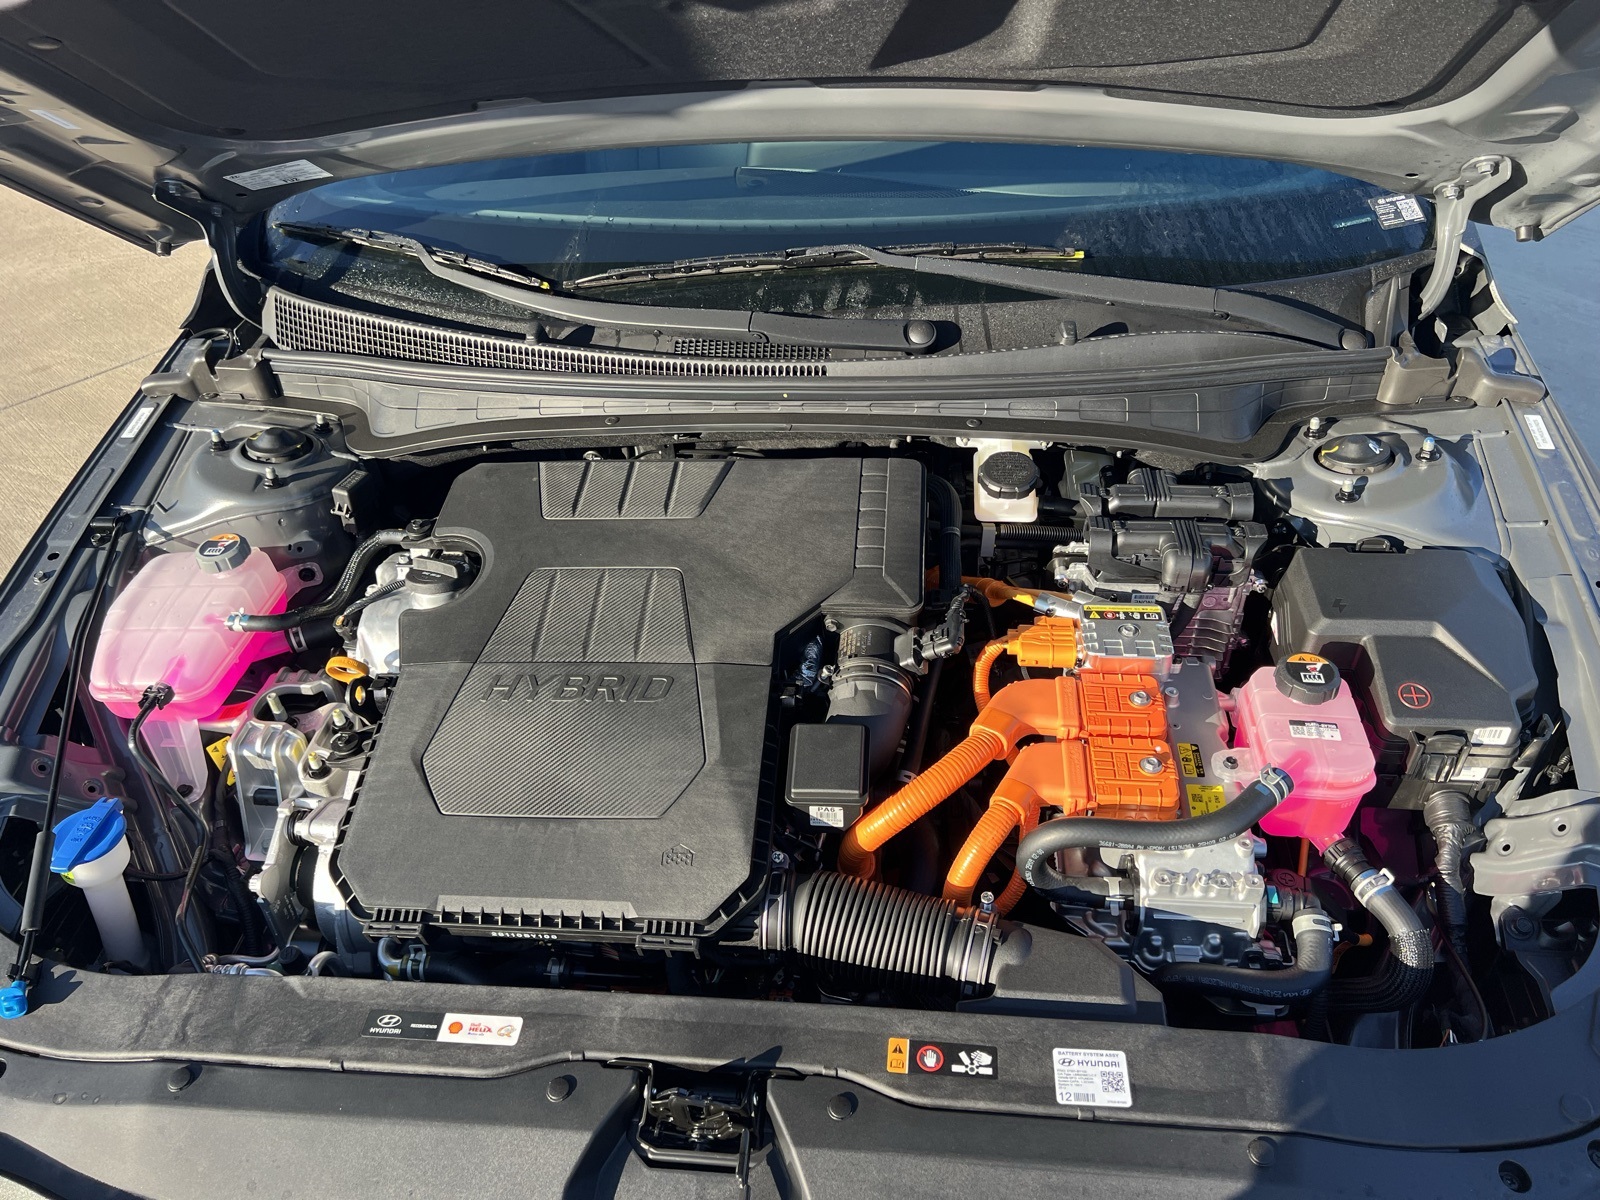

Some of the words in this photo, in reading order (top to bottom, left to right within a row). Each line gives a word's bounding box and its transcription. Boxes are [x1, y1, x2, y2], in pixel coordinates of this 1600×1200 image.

[480, 674, 675, 702] HYBRID
[468, 1025, 493, 1033] HELIX
[1077, 1060, 1120, 1068] HYUNDAI
[1059, 1092, 1073, 1102] 12
